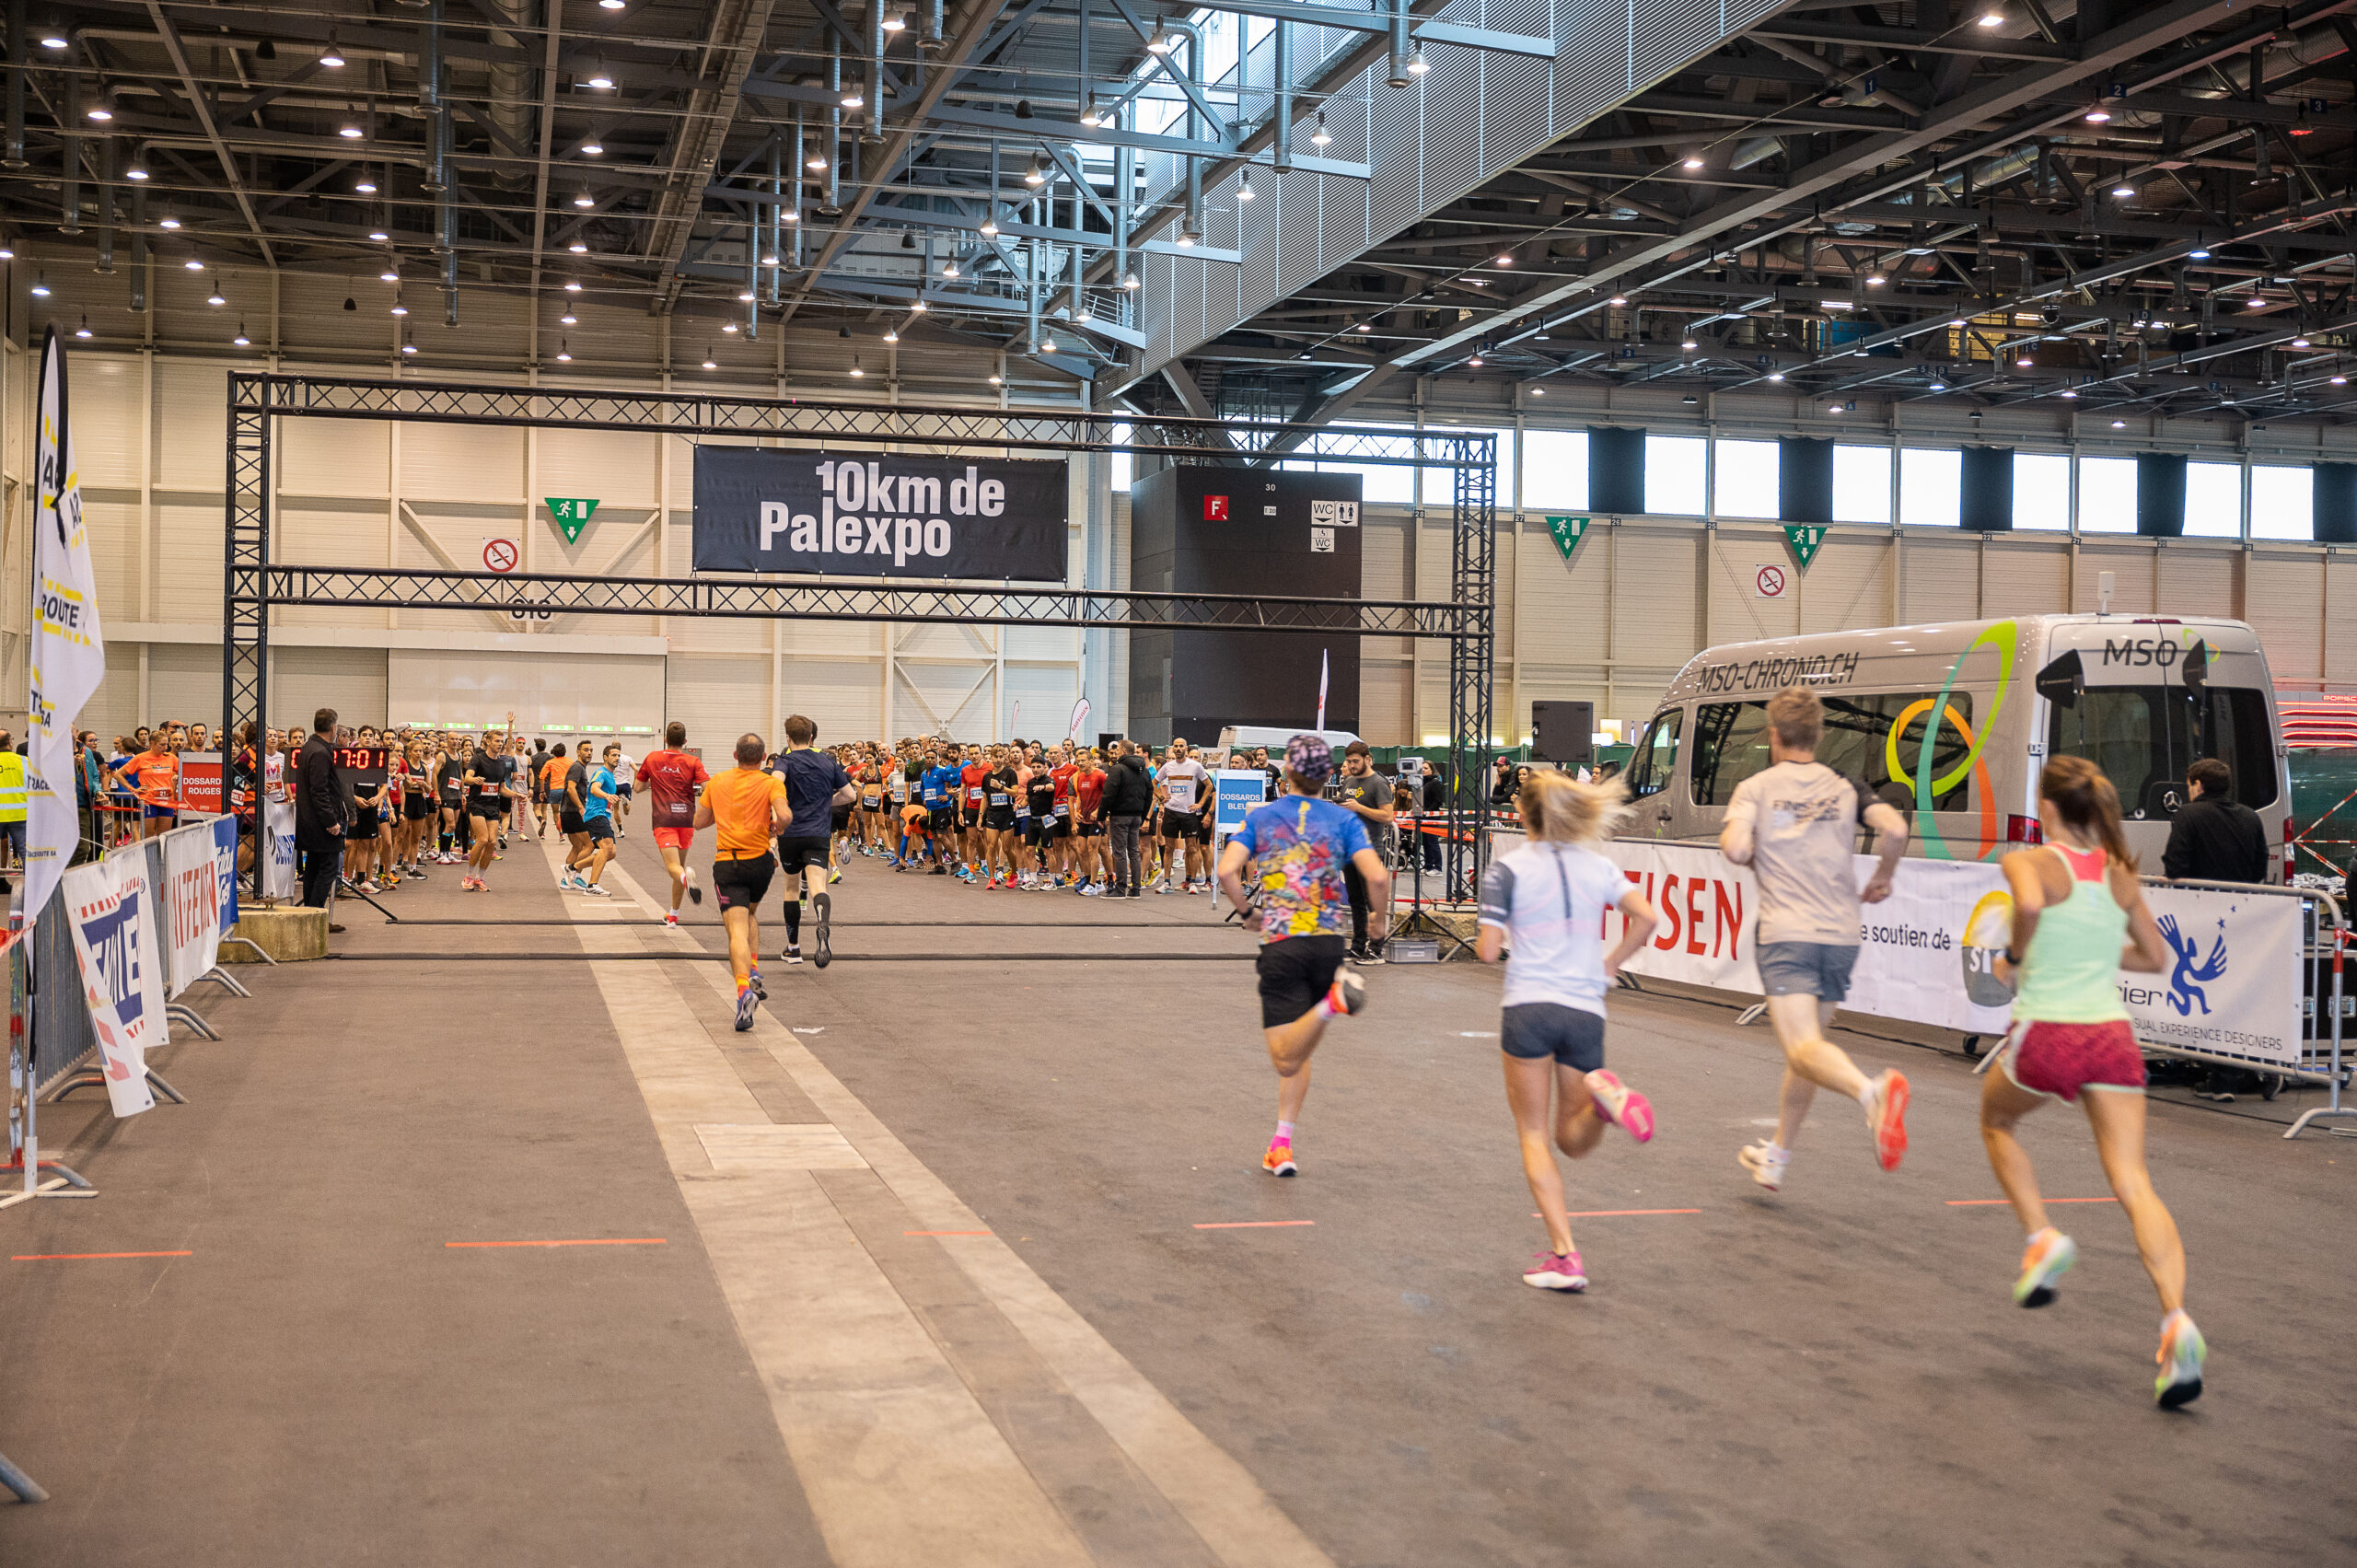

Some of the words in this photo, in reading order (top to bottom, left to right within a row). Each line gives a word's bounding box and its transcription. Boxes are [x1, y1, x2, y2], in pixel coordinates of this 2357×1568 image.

[2114, 84, 2121, 96] 2
[2315, 100, 2322, 111] 3
[815, 460, 941, 515] 10km
[949, 466, 1005, 517] de
[1265, 483, 1276, 492] 30
[1211, 500, 1222, 516] F
[1313, 504, 1333, 515] WC
[760, 496, 951, 567] Palexpo
[1315, 539, 1330, 547] WC
[2103, 639, 2177, 667] MSO
[1696, 650, 1860, 694] MSO-CHRONO.CH
[183, 777, 223, 785] DOSSARD
[1220, 793, 1260, 802] DOSSARDS
[1227, 802, 1247, 810] BLEU
[1872, 923, 1928, 948] soutien
[1932, 927, 1952, 951] de
[2133, 1016, 2158, 1032] SUAL
[2160, 1021, 2222, 1042] EXPERIENCE
[2225, 1029, 2283, 1051] DESIGNERS
